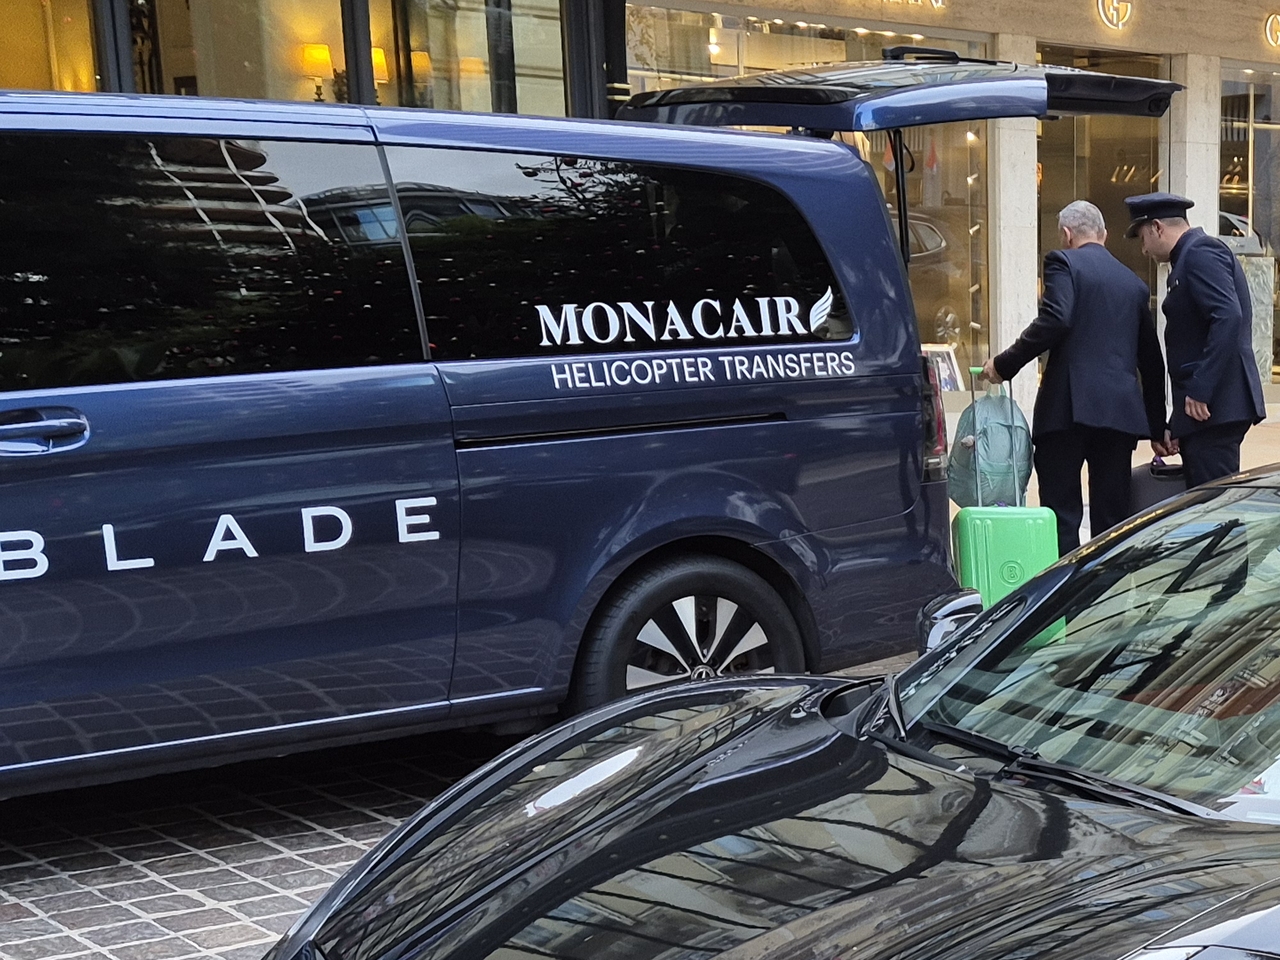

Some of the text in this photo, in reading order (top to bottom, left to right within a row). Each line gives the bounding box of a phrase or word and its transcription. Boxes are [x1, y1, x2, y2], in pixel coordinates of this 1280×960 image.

[534, 295, 808, 346] MONACAIR
[551, 351, 856, 390] HELICOPTER TRANSFERS
[0, 496, 441, 581] BLADE
